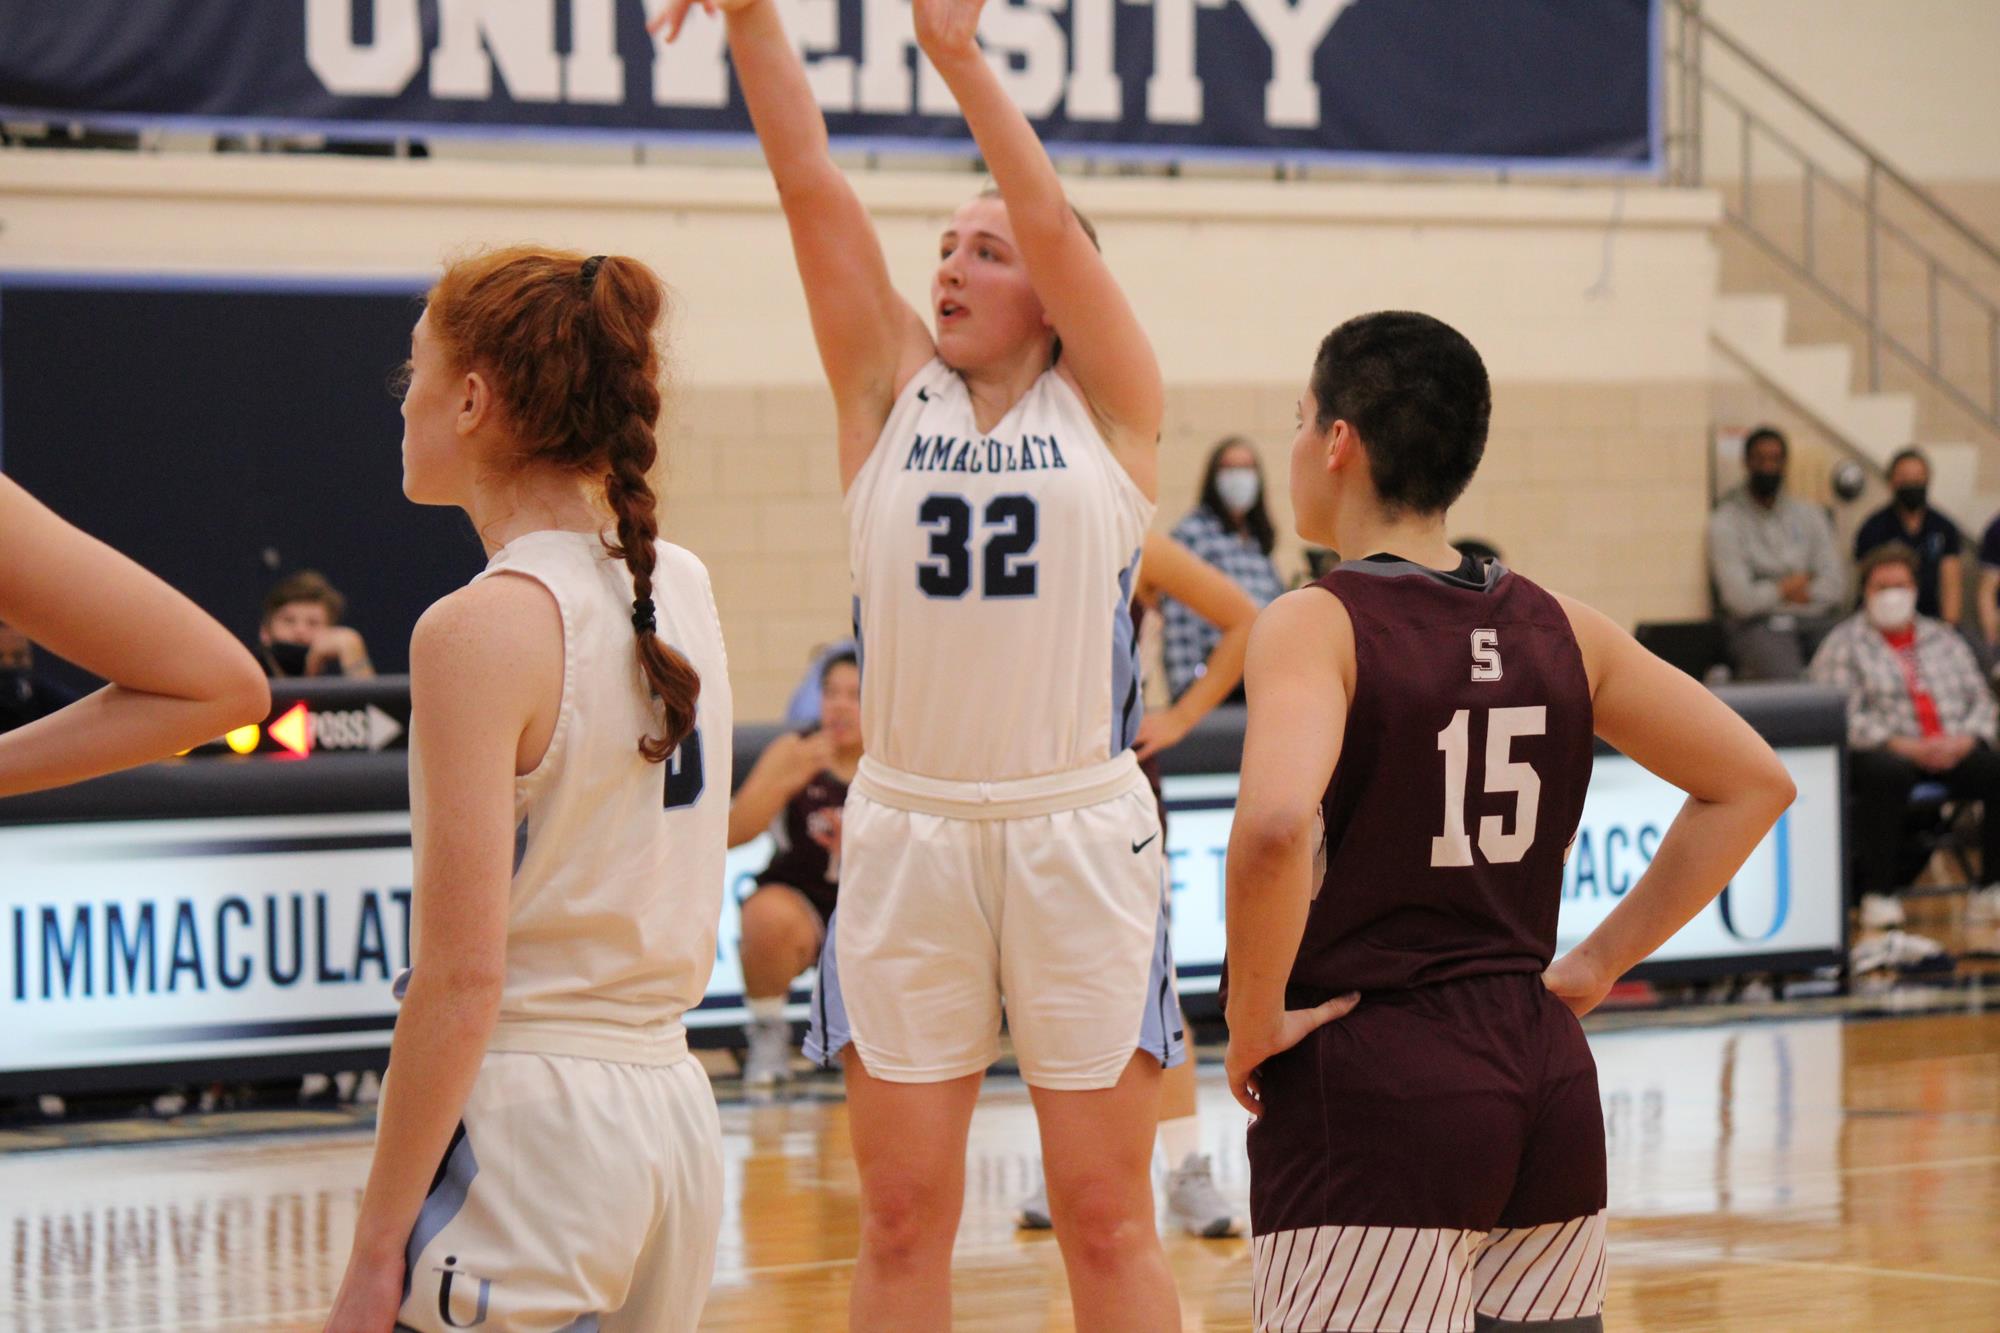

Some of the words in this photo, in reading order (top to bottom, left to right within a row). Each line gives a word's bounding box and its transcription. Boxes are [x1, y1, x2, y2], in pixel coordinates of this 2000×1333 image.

[916, 493, 1038, 600] 32
[1471, 628, 1503, 682] S
[1430, 705, 1547, 867] 15
[12, 890, 412, 1001] IMMACULAT
